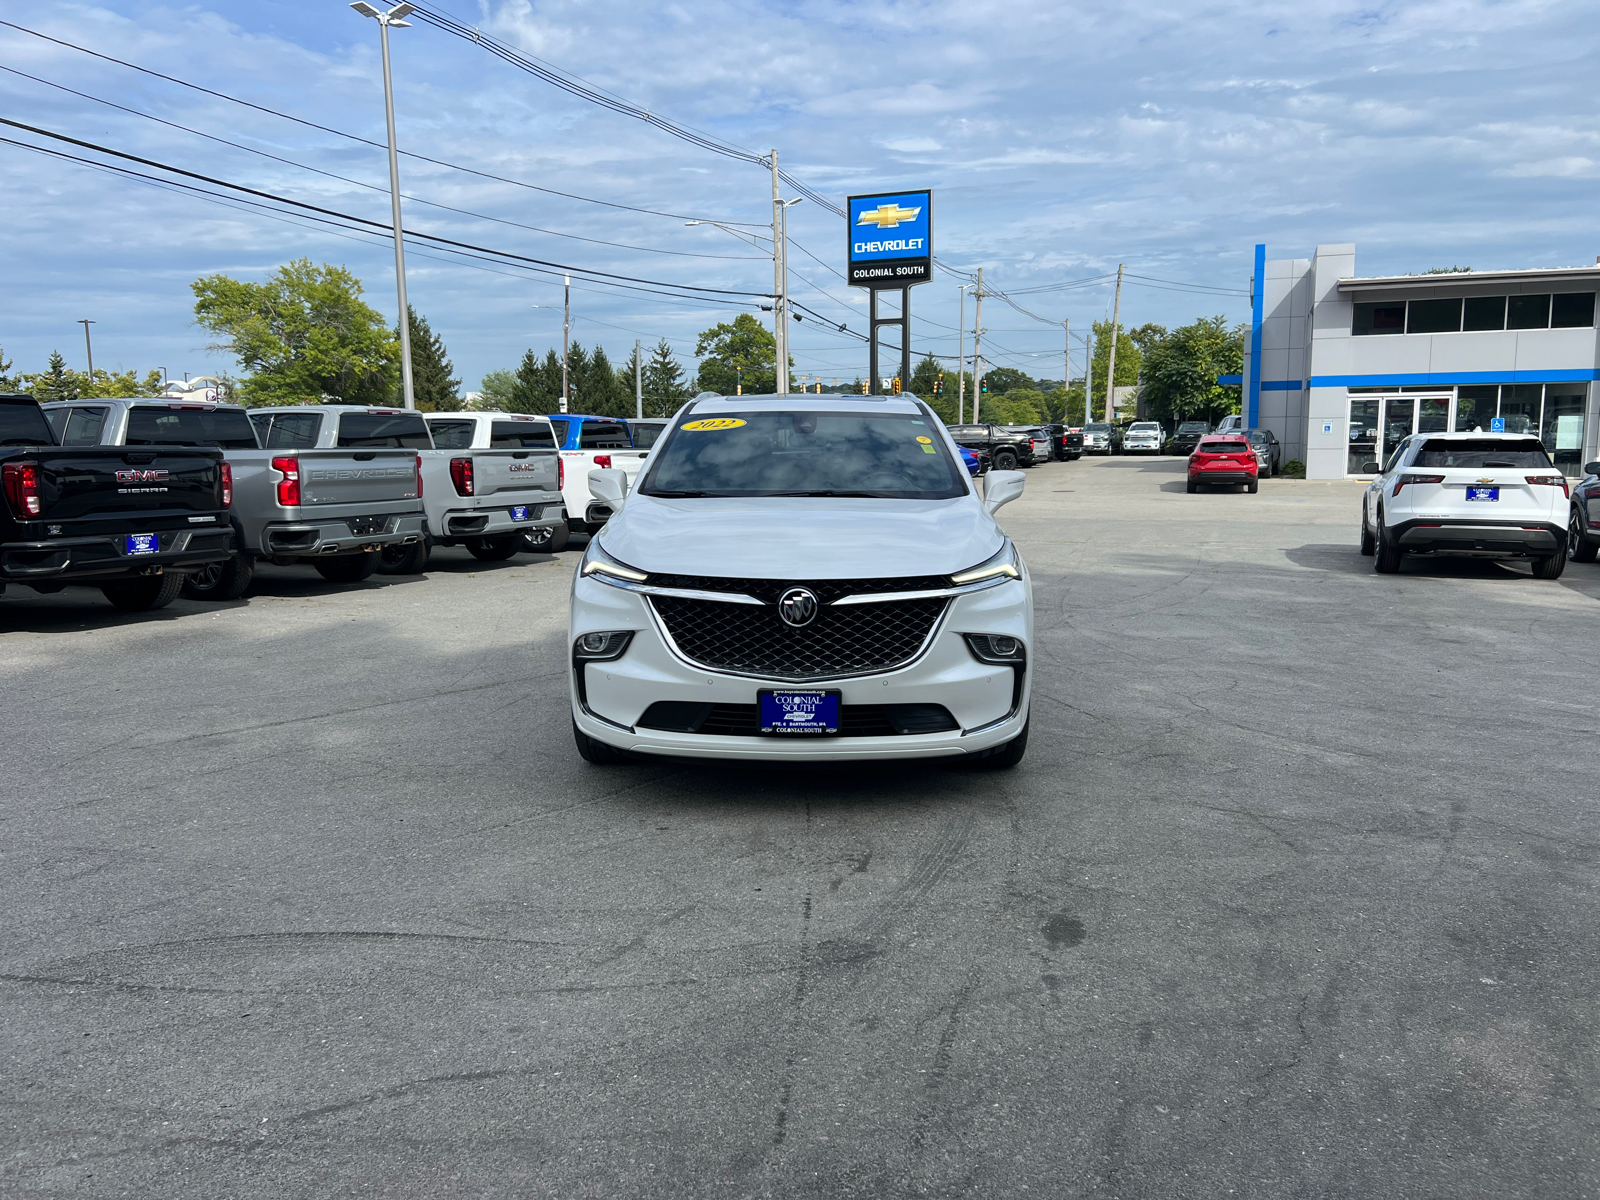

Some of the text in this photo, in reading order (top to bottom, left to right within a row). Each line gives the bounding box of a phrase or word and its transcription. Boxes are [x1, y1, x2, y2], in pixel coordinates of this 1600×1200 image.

[854, 238, 924, 253] CHEVROLET
[853, 266, 924, 278] COLONIAL SOUTH
[690, 420, 736, 430] 2022
[311, 467, 412, 480] CHEVROLET
[508, 463, 535, 473] GMC
[116, 469, 169, 483] GMC
[775, 696, 823, 704] COLONIAL
[782, 703, 815, 712] SOUTH
